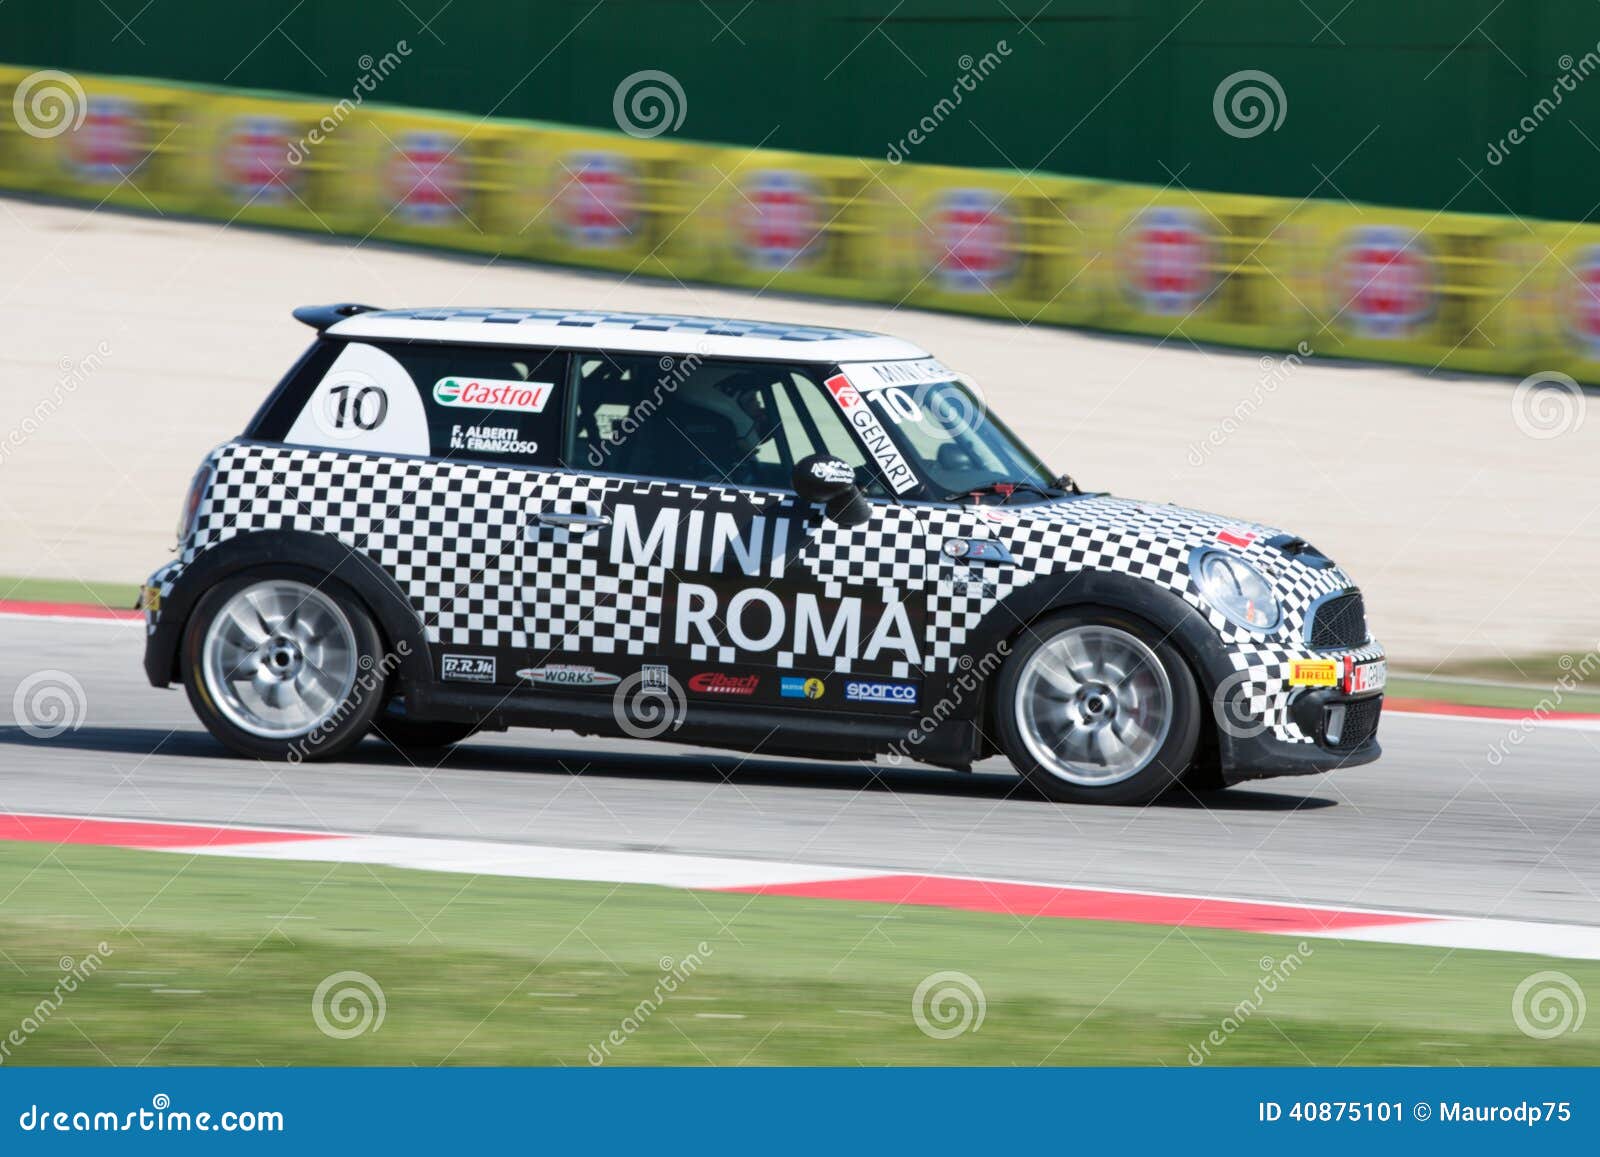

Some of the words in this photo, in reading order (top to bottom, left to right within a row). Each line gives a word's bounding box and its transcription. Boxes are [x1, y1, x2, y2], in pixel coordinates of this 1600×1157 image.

[461, 382, 543, 408] Castrol
[866, 387, 924, 425] 10
[329, 385, 389, 431] 10
[452, 425, 463, 438] F.
[466, 426, 518, 441] ALBERTI
[450, 438, 465, 449] N.
[467, 440, 538, 454] FRANZOSO
[853, 410, 917, 491] GENART
[609, 503, 791, 579] MINI
[675, 582, 923, 666] ROMA
[544, 671, 594, 684] WORKS
[688, 672, 761, 695] Eibach
[1295, 664, 1335, 680] PIRELLI
[847, 682, 917, 701] sparco
